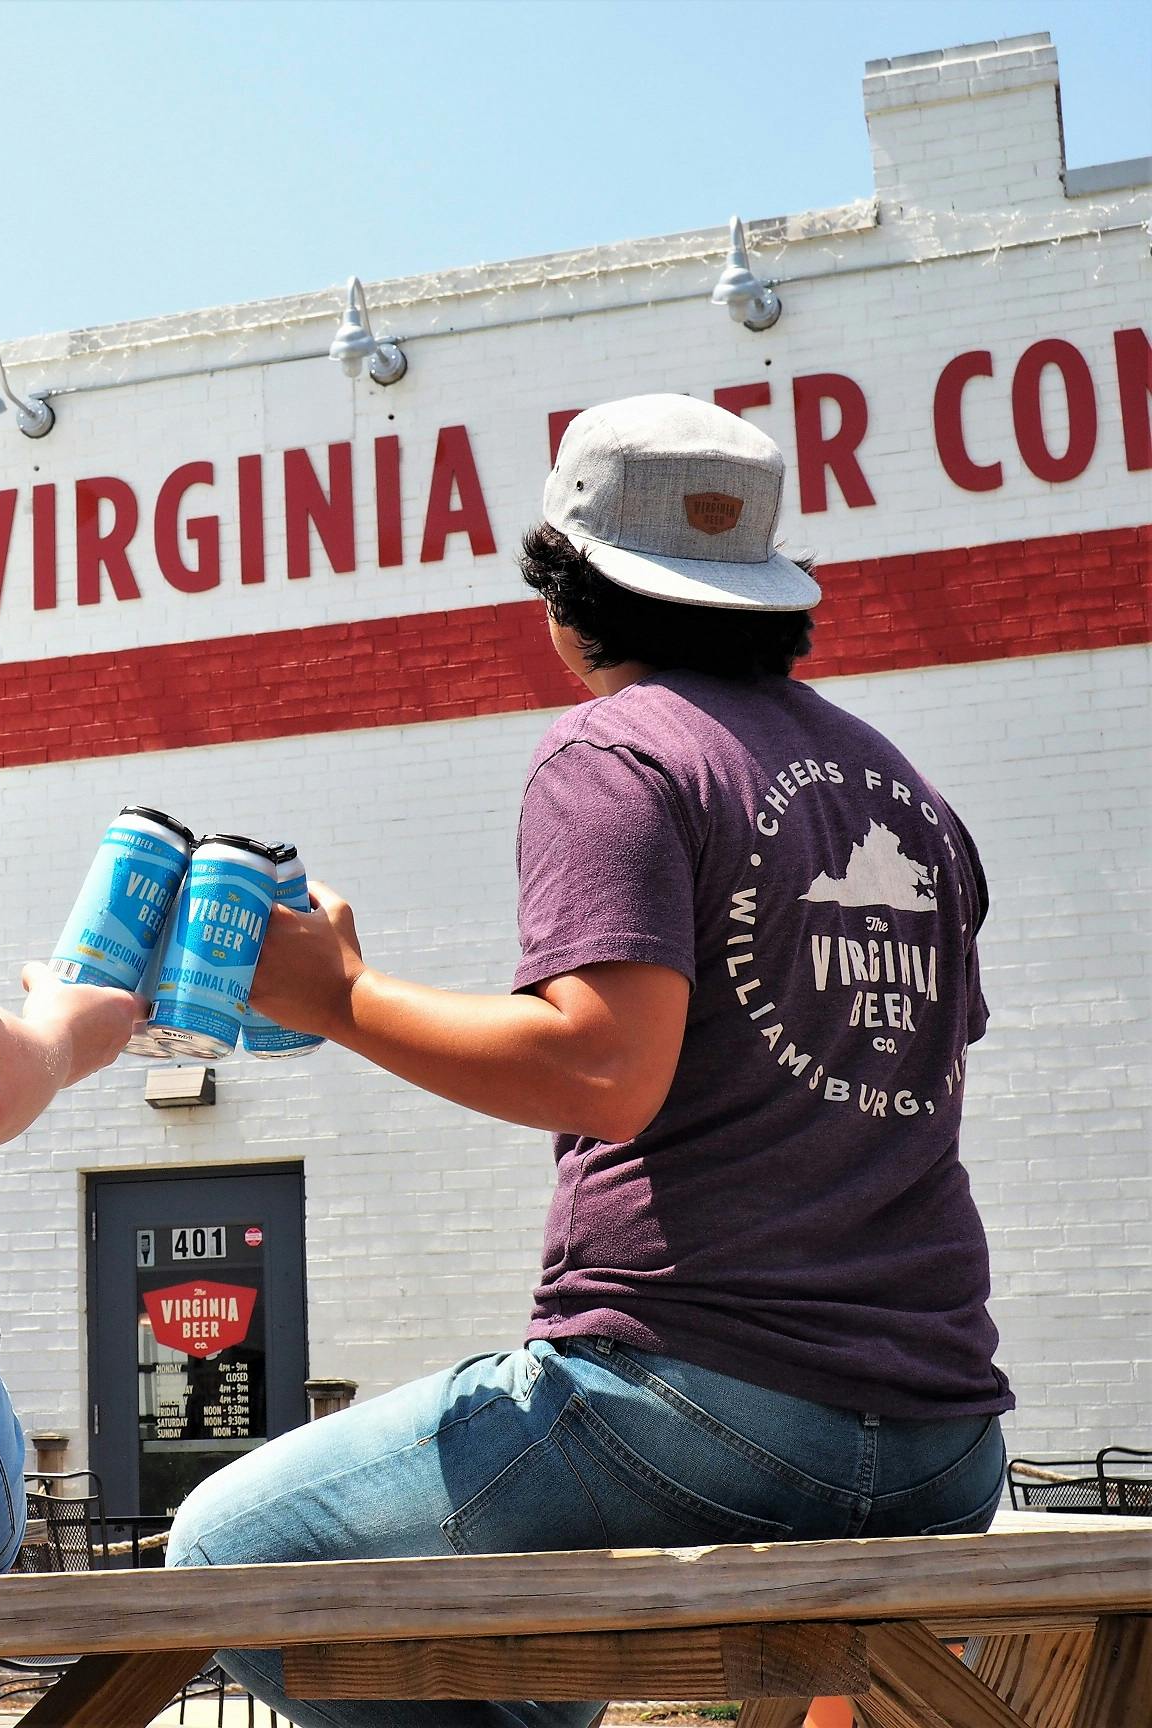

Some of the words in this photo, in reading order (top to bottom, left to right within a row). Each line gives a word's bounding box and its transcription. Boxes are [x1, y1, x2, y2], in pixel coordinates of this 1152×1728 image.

[756, 758, 844, 837] CHEERS
[188, 897, 263, 944] VIRGINIA
[865, 916, 888, 933] The
[203, 924, 244, 952] BEER
[811, 934, 938, 1002] VIRGINIA
[726, 886, 935, 1118] WILLIAMSBURG,
[848, 990, 916, 1032] BEER
[872, 1036, 898, 1055] CO.
[174, 1228, 222, 1258] 401
[160, 1297, 239, 1324] VIRGINIA
[182, 1321, 220, 1338] BEER
[156, 1364, 182, 1374] MONDAY
[226, 1373, 248, 1382] CLOSED
[156, 1418, 188, 1428] SATURDAY
[204, 1416, 222, 1426] NOON
[157, 1407, 179, 1417] FRIDAY
[203, 1406, 222, 1415] NOON
[157, 1428, 182, 1438] SUNDAY
[213, 1427, 231, 1437] NOON
